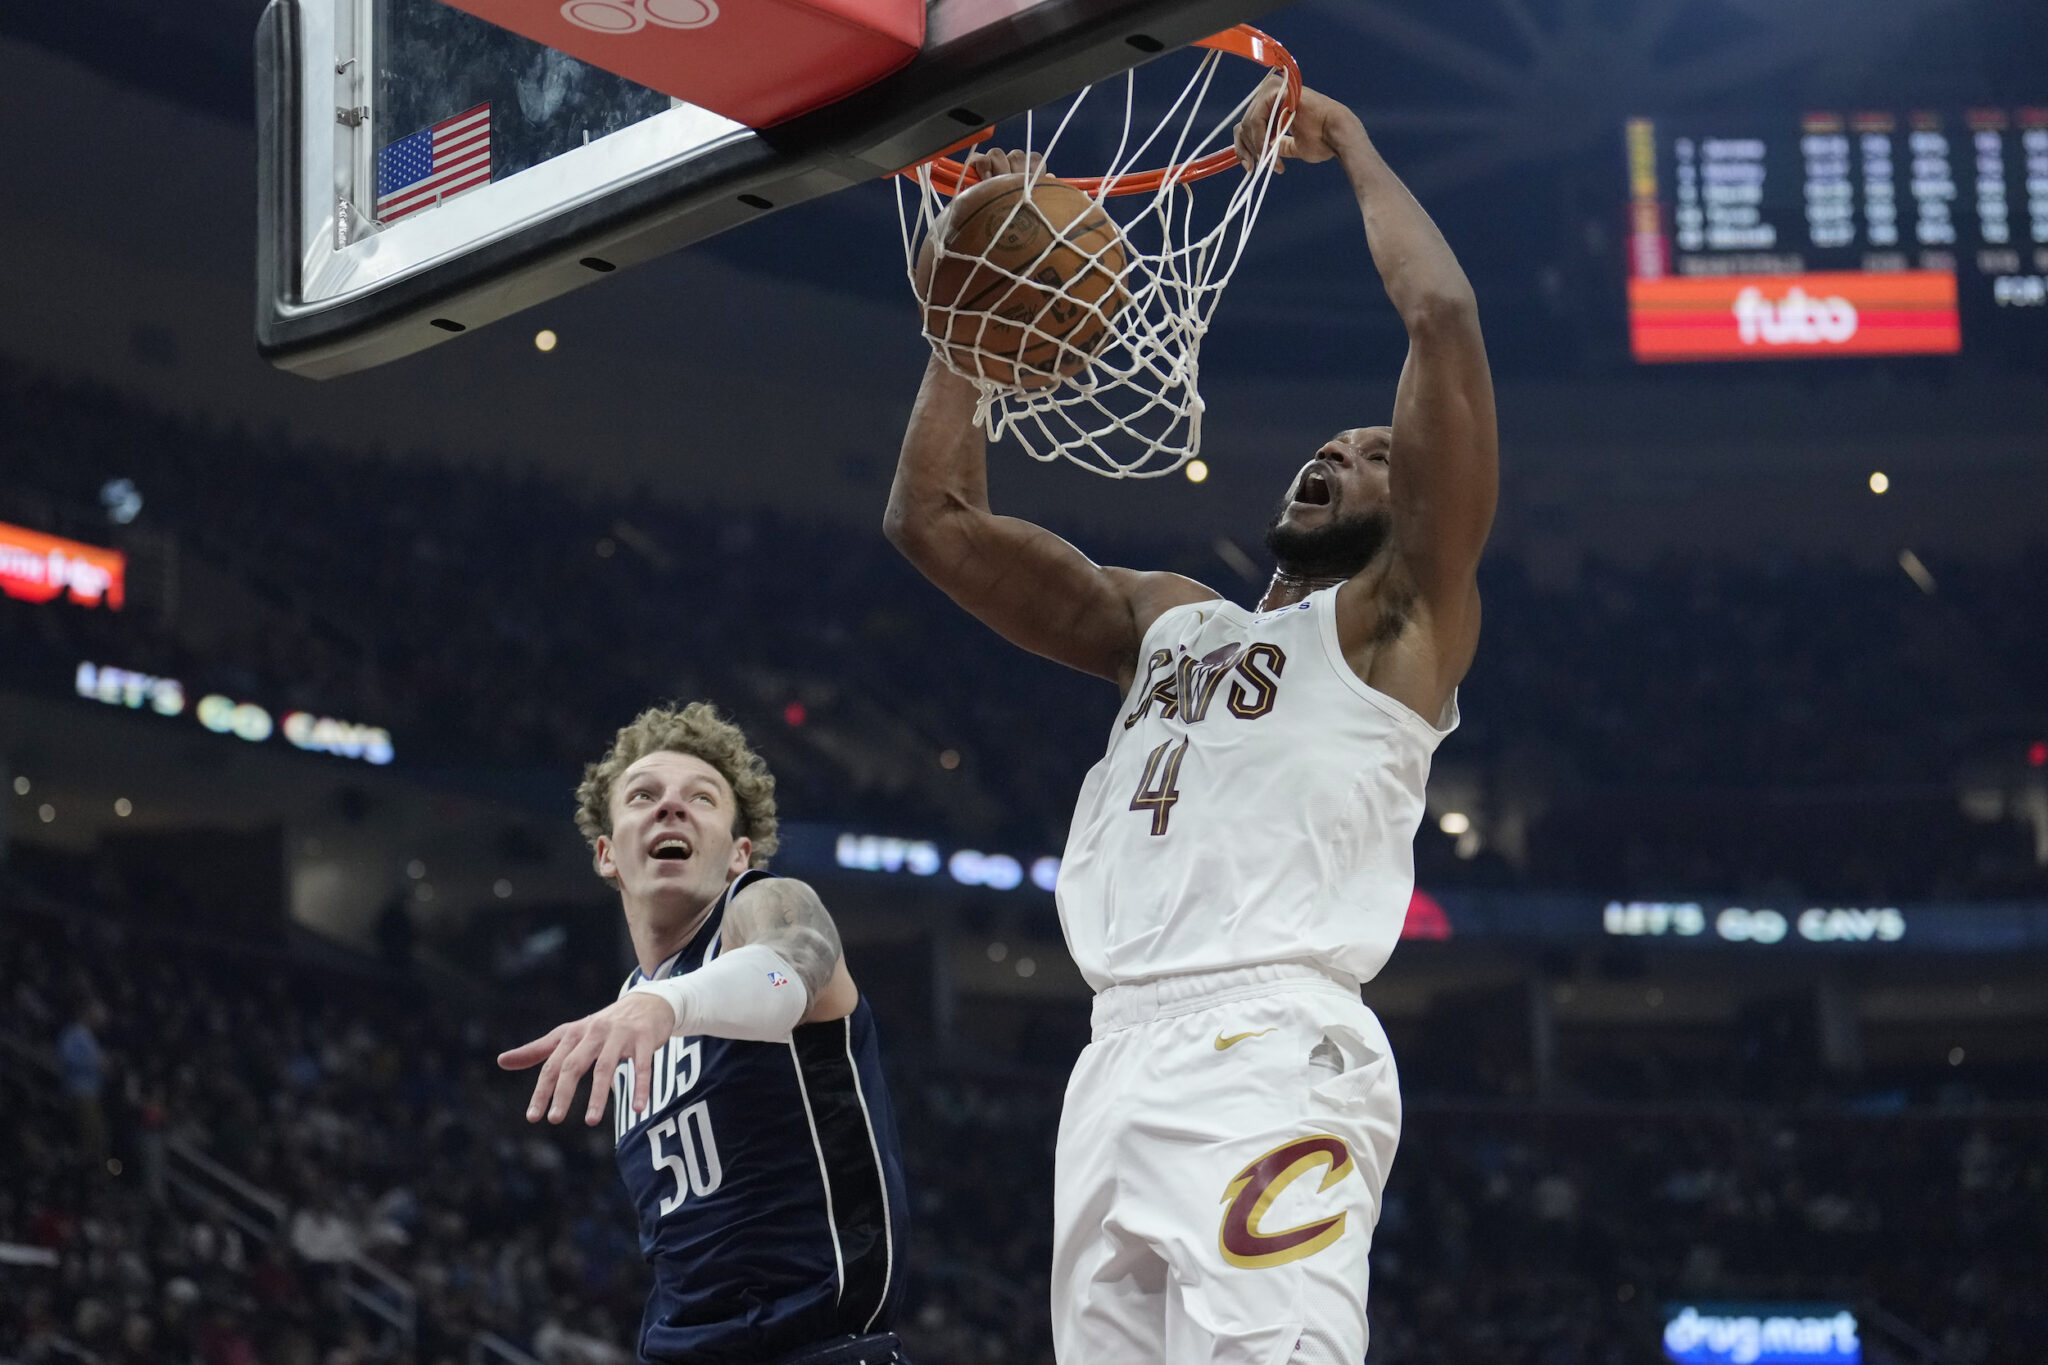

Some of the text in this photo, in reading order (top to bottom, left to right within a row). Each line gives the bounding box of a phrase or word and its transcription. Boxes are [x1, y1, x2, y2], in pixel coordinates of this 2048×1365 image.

[1734, 286, 1858, 344] fubo
[75, 660, 395, 765] LET'S GO CAVS
[1125, 641, 1287, 730] CAVS
[1129, 734, 1189, 836] 4
[949, 849, 1023, 891] GO
[1602, 900, 1906, 943] LET'S GO CAVS
[647, 1100, 723, 1217] 50
[1219, 1133, 1355, 1270] C
